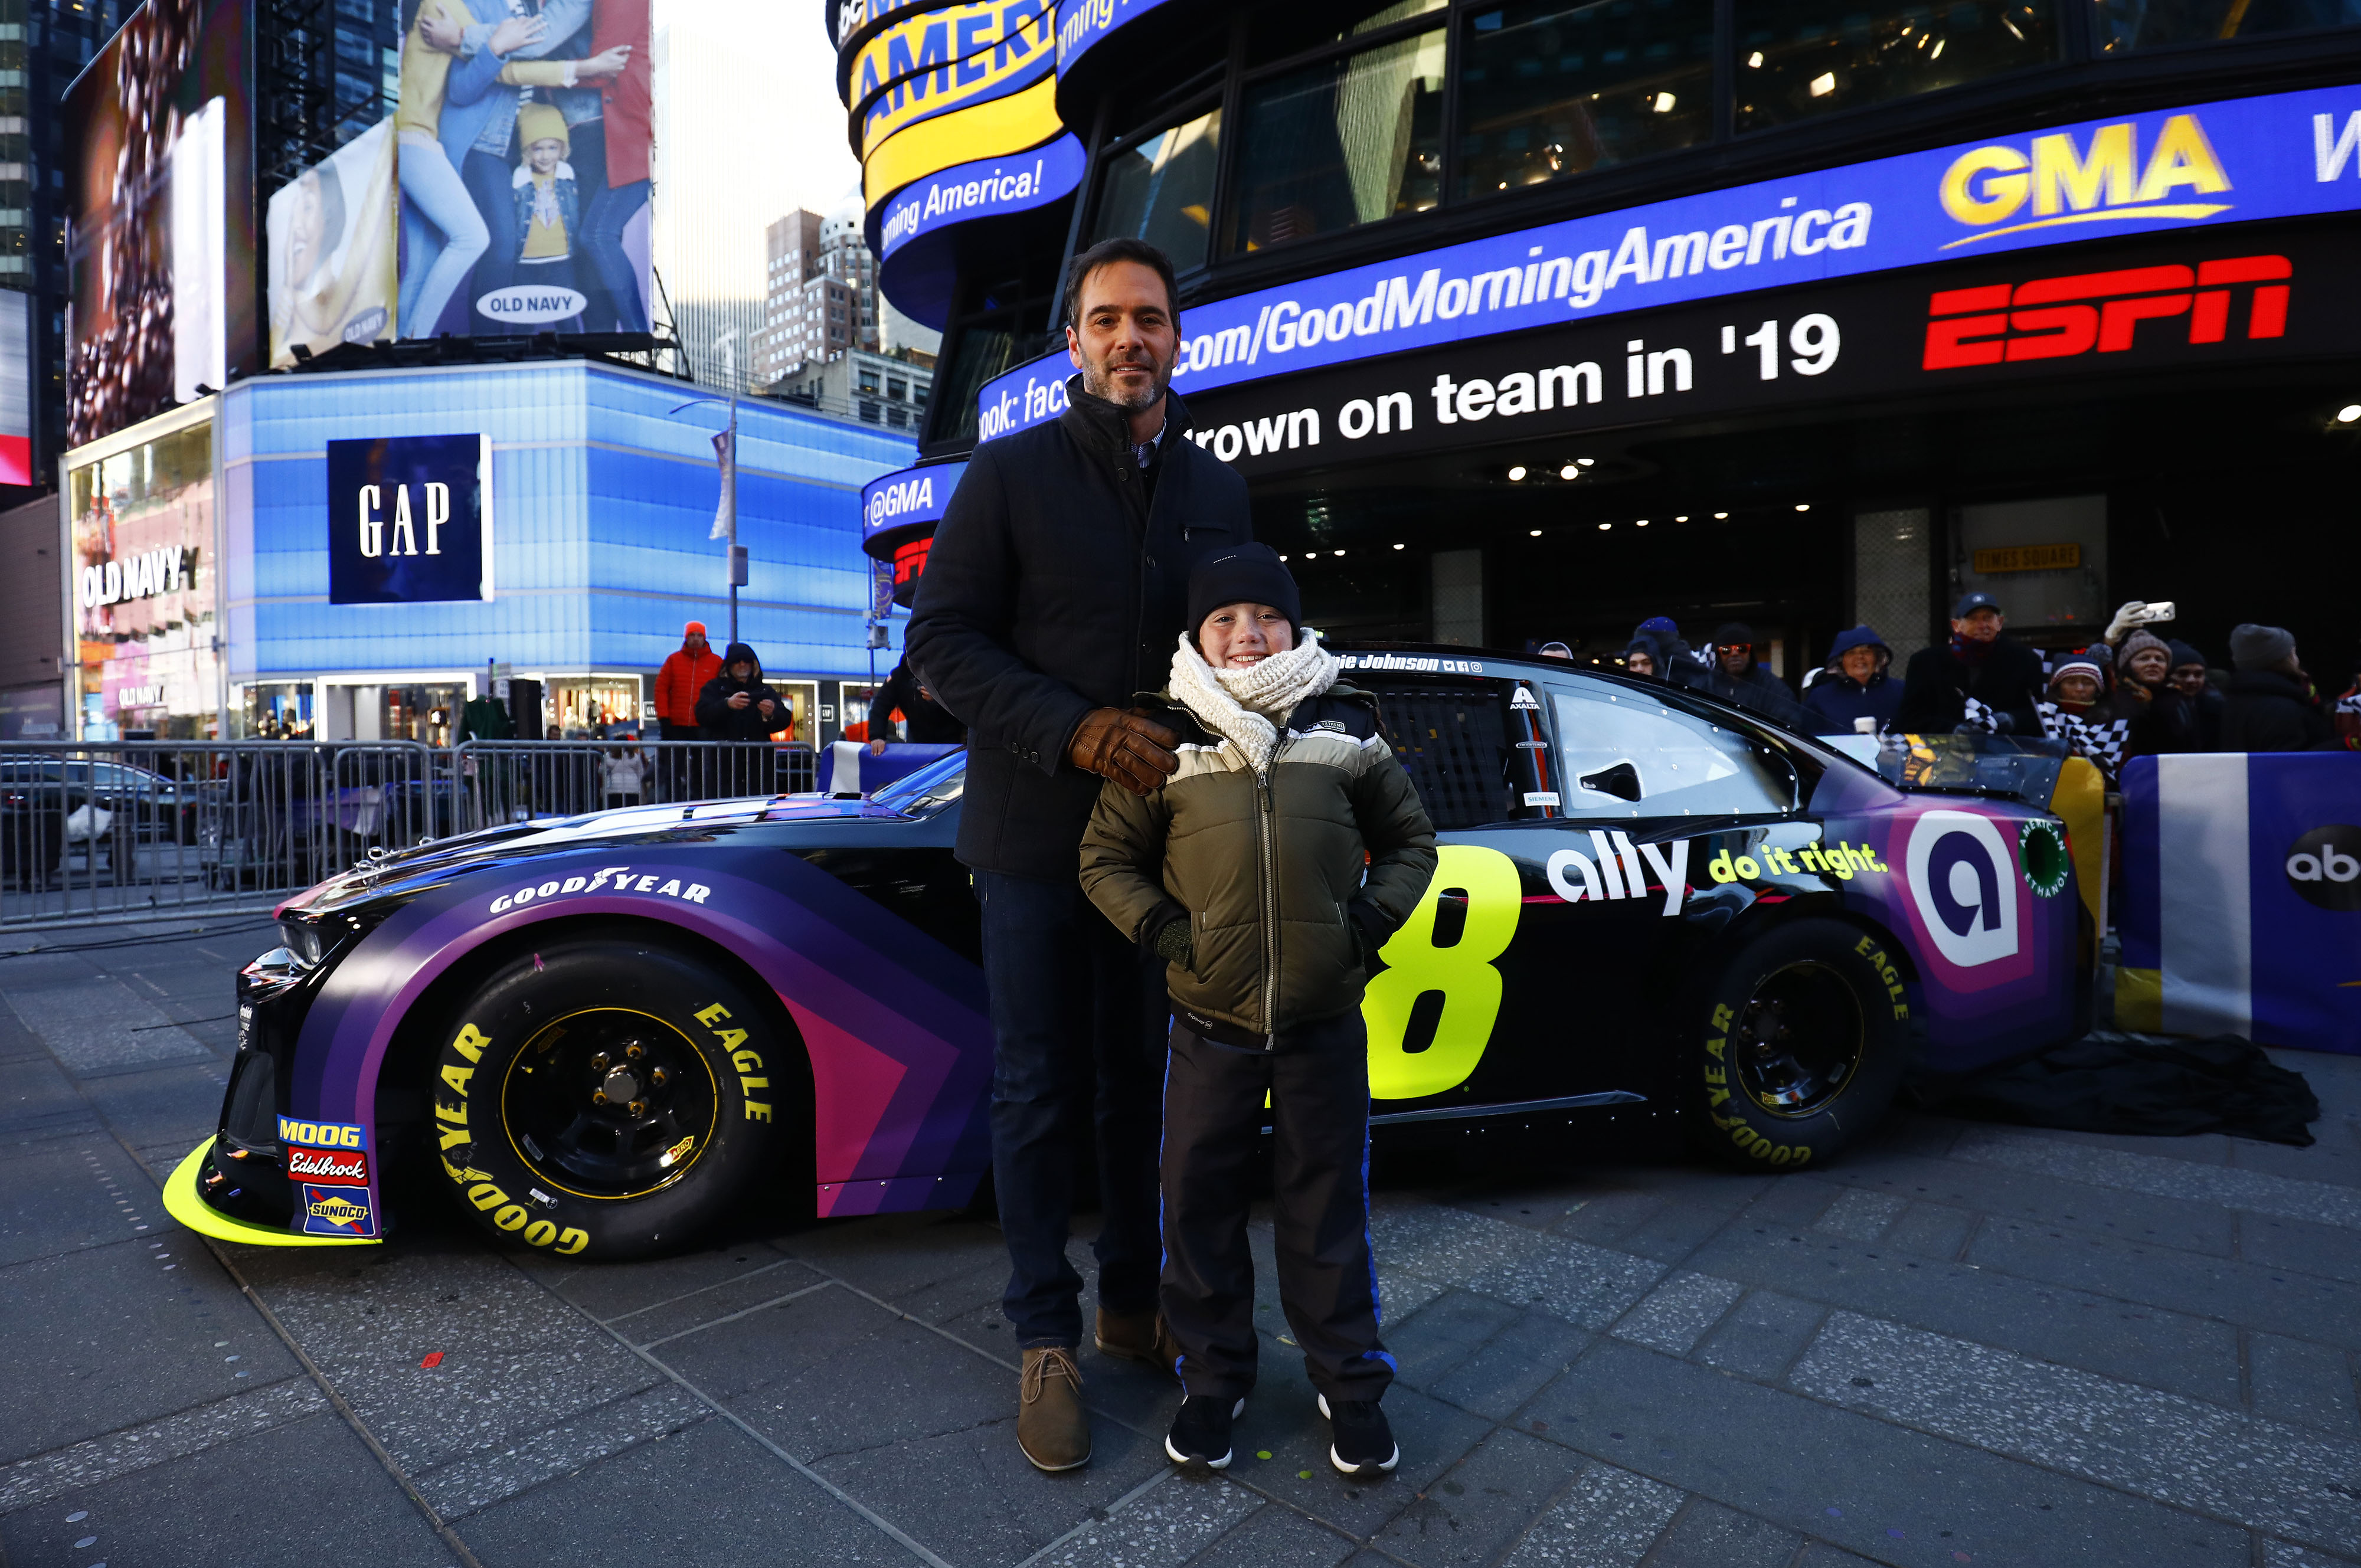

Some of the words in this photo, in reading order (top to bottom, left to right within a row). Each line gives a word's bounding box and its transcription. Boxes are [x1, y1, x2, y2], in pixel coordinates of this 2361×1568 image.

[838, 0, 864, 45] bc
[1057, 0, 1114, 66] orning
[1939, 113, 2234, 225] GMA
[881, 201, 920, 250] orning
[923, 159, 1043, 221] America!
[490, 297, 522, 312] OLD
[527, 296, 572, 312] NAVY
[978, 390, 1019, 444] ook:
[1172, 197, 1873, 377] com/GoodMorningAmerica
[1922, 255, 2293, 371] ESPN
[1183, 407, 1320, 463] rown
[1338, 391, 1413, 440] on
[1431, 360, 1603, 424] team
[1627, 339, 1693, 398] in
[1721, 312, 1841, 382] '19
[359, 482, 450, 558] GAP
[870, 477, 933, 527] @GMA
[82, 561, 122, 608] OLD
[123, 544, 183, 600] NAVY
[1978, 551, 2018, 568] TIMES
[2023, 546, 2076, 565] SQUARE
[1358, 653, 1439, 671] Johnson
[119, 688, 135, 706] OLD
[135, 685, 160, 705] NAVY
[2019, 818, 2066, 851] AMERICAN
[1546, 830, 1690, 916] ally
[1709, 849, 1761, 883] do
[1764, 844, 1800, 876] it
[1798, 840, 1889, 880] right.
[2025, 870, 2069, 898] ETHANOL
[2286, 843, 2361, 882] ab
[1360, 844, 1522, 1100] 8
[1855, 935, 1909, 1020] EAGLE
[692, 1002, 772, 1124] EAGLE
[280, 1118, 361, 1147] MOOG
[672, 1140, 690, 1158] AERO
[289, 1152, 365, 1179] Edelbrock
[312, 1204, 365, 1219] SUNOCO
